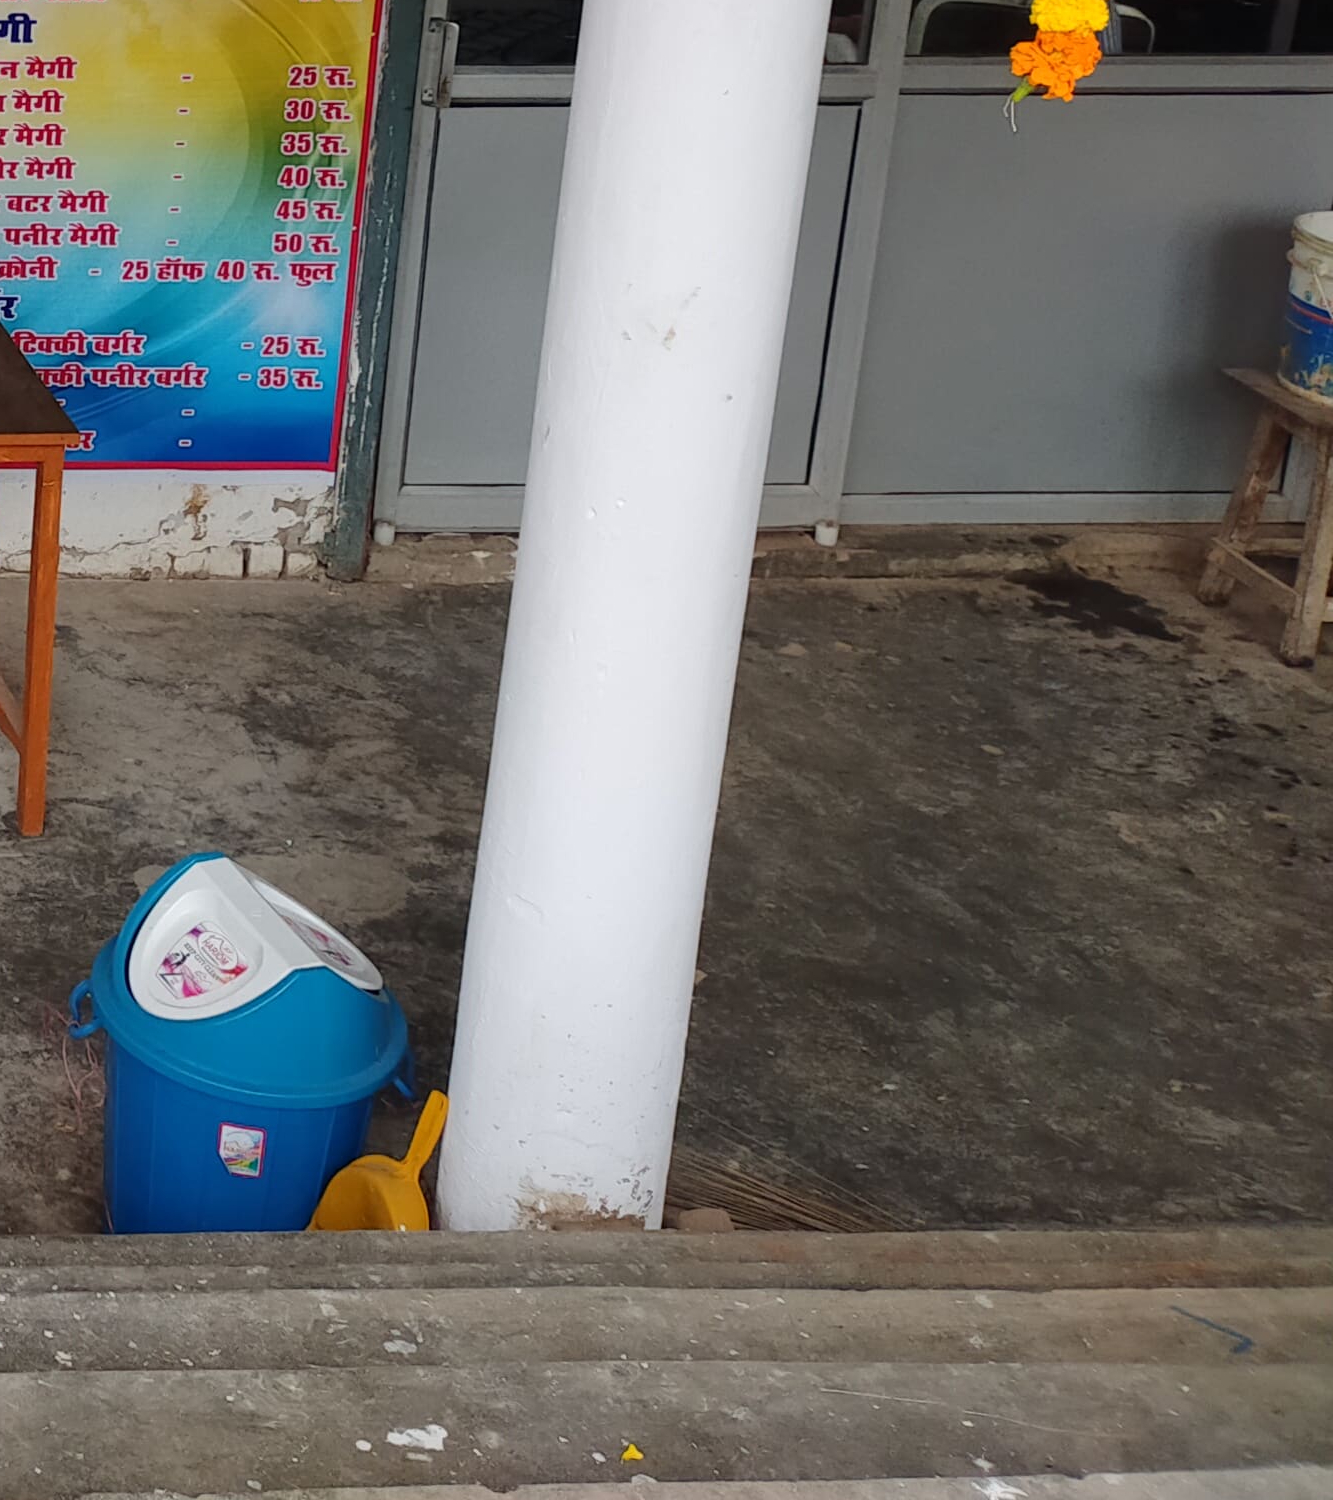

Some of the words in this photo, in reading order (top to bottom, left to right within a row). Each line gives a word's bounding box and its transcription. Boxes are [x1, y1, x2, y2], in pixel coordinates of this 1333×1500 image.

[25, 54, 76, 81] मैगी
[289, 66, 319, 88] 25
[13, 88, 64, 115] मैगी
[285, 98, 315, 121] 30
[15, 122, 66, 148] मैगी
[282, 133, 312, 154] 35
[25, 156, 75, 181] मैगी
[280, 167, 310, 187] 40
[7, 195, 53, 213] बटर
[59, 190, 108, 213] मैगी
[276, 200, 307, 220] 45
[4, 223, 63, 246] पनीर
[70, 223, 118, 246] मैगी
[274, 233, 303, 253] 50
[122, 260, 149, 281] 25
[157, 258, 203, 281] हॉफ
[217, 261, 245, 280] 40
[290, 263, 335, 286] फुल
[94, 332, 143, 354] बर्गर
[263, 336, 290, 356] 25
[91, 364, 150, 386] पनीर
[156, 365, 205, 386] बर्गर
[260, 369, 286, 387] 35
